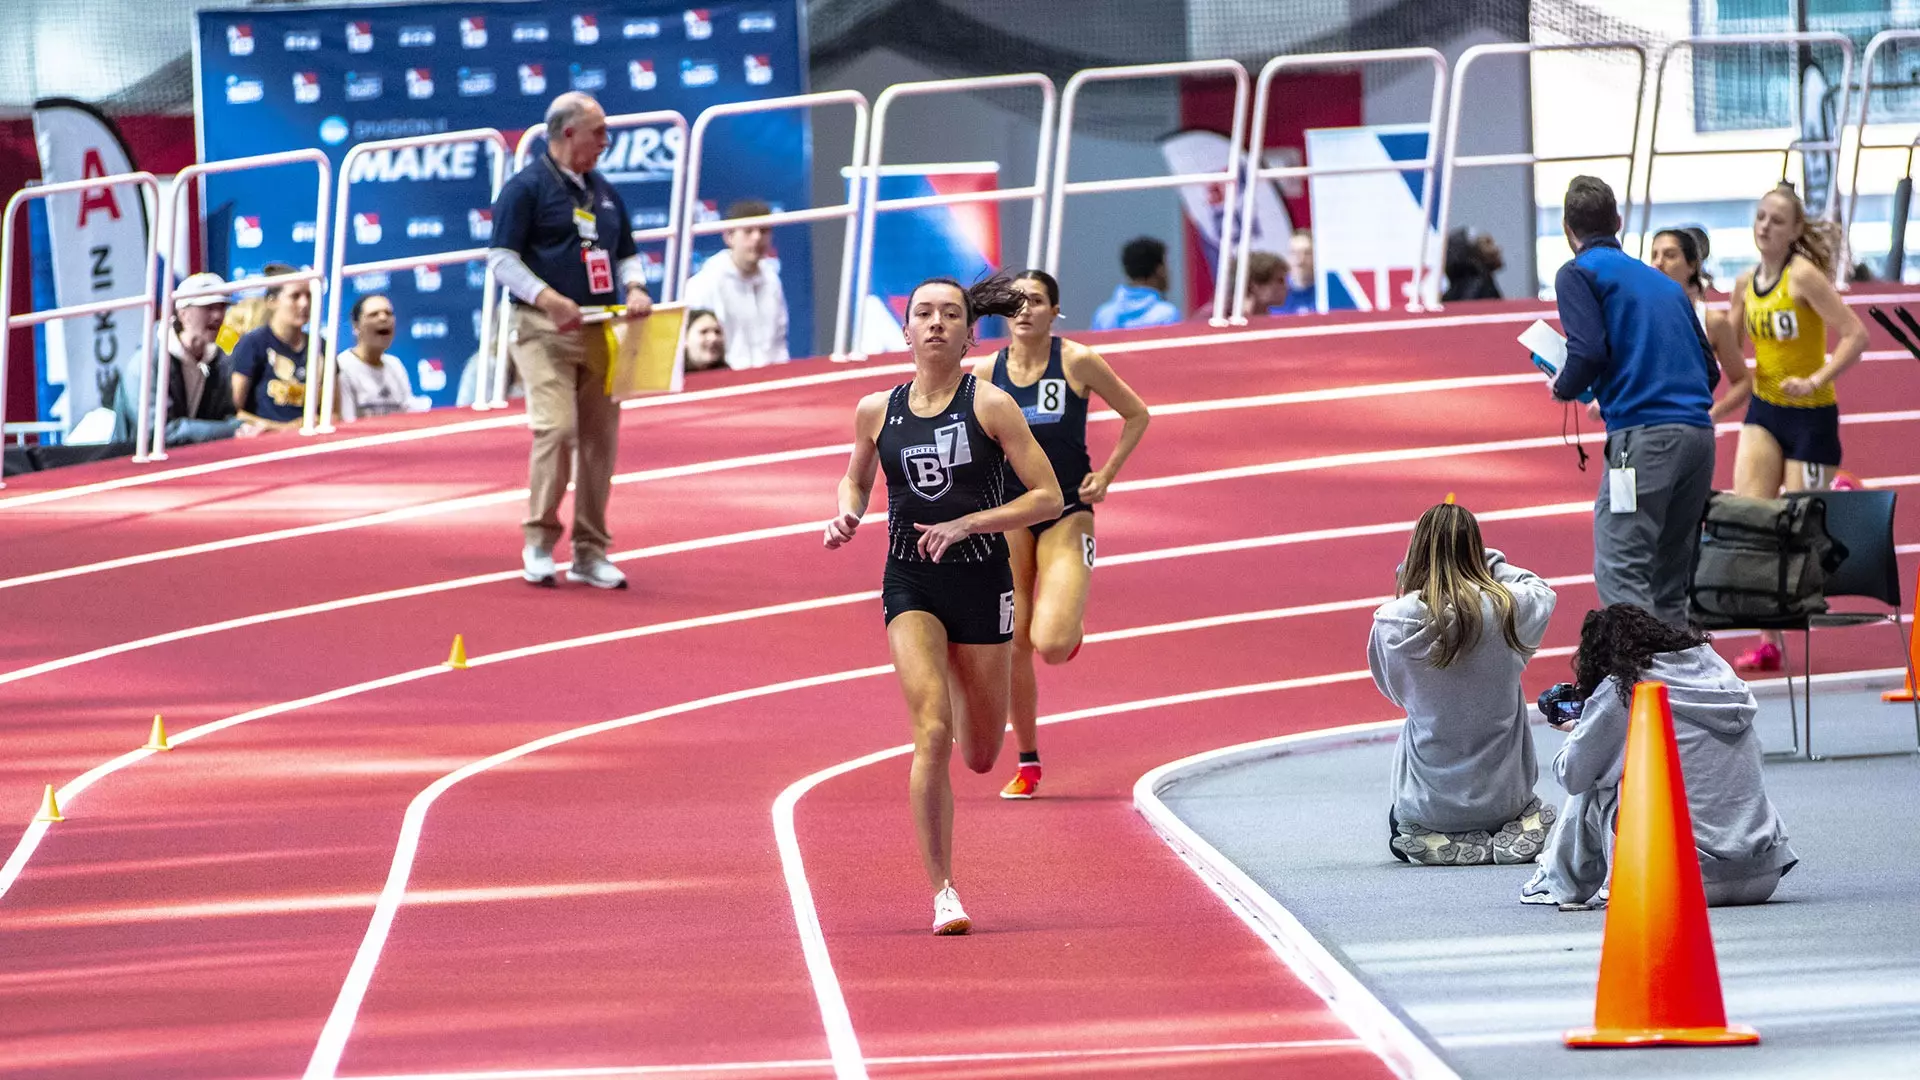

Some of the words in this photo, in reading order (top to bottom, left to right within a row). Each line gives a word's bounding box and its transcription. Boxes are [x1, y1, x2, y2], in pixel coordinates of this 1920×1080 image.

[349, 141, 477, 184] MAKE
[77, 147, 122, 228] A
[1778, 312, 1793, 337] 9
[1044, 382, 1059, 411] 8
[940, 426, 959, 465] 7
[910, 458, 944, 487] B
[1086, 538, 1095, 566] 8
